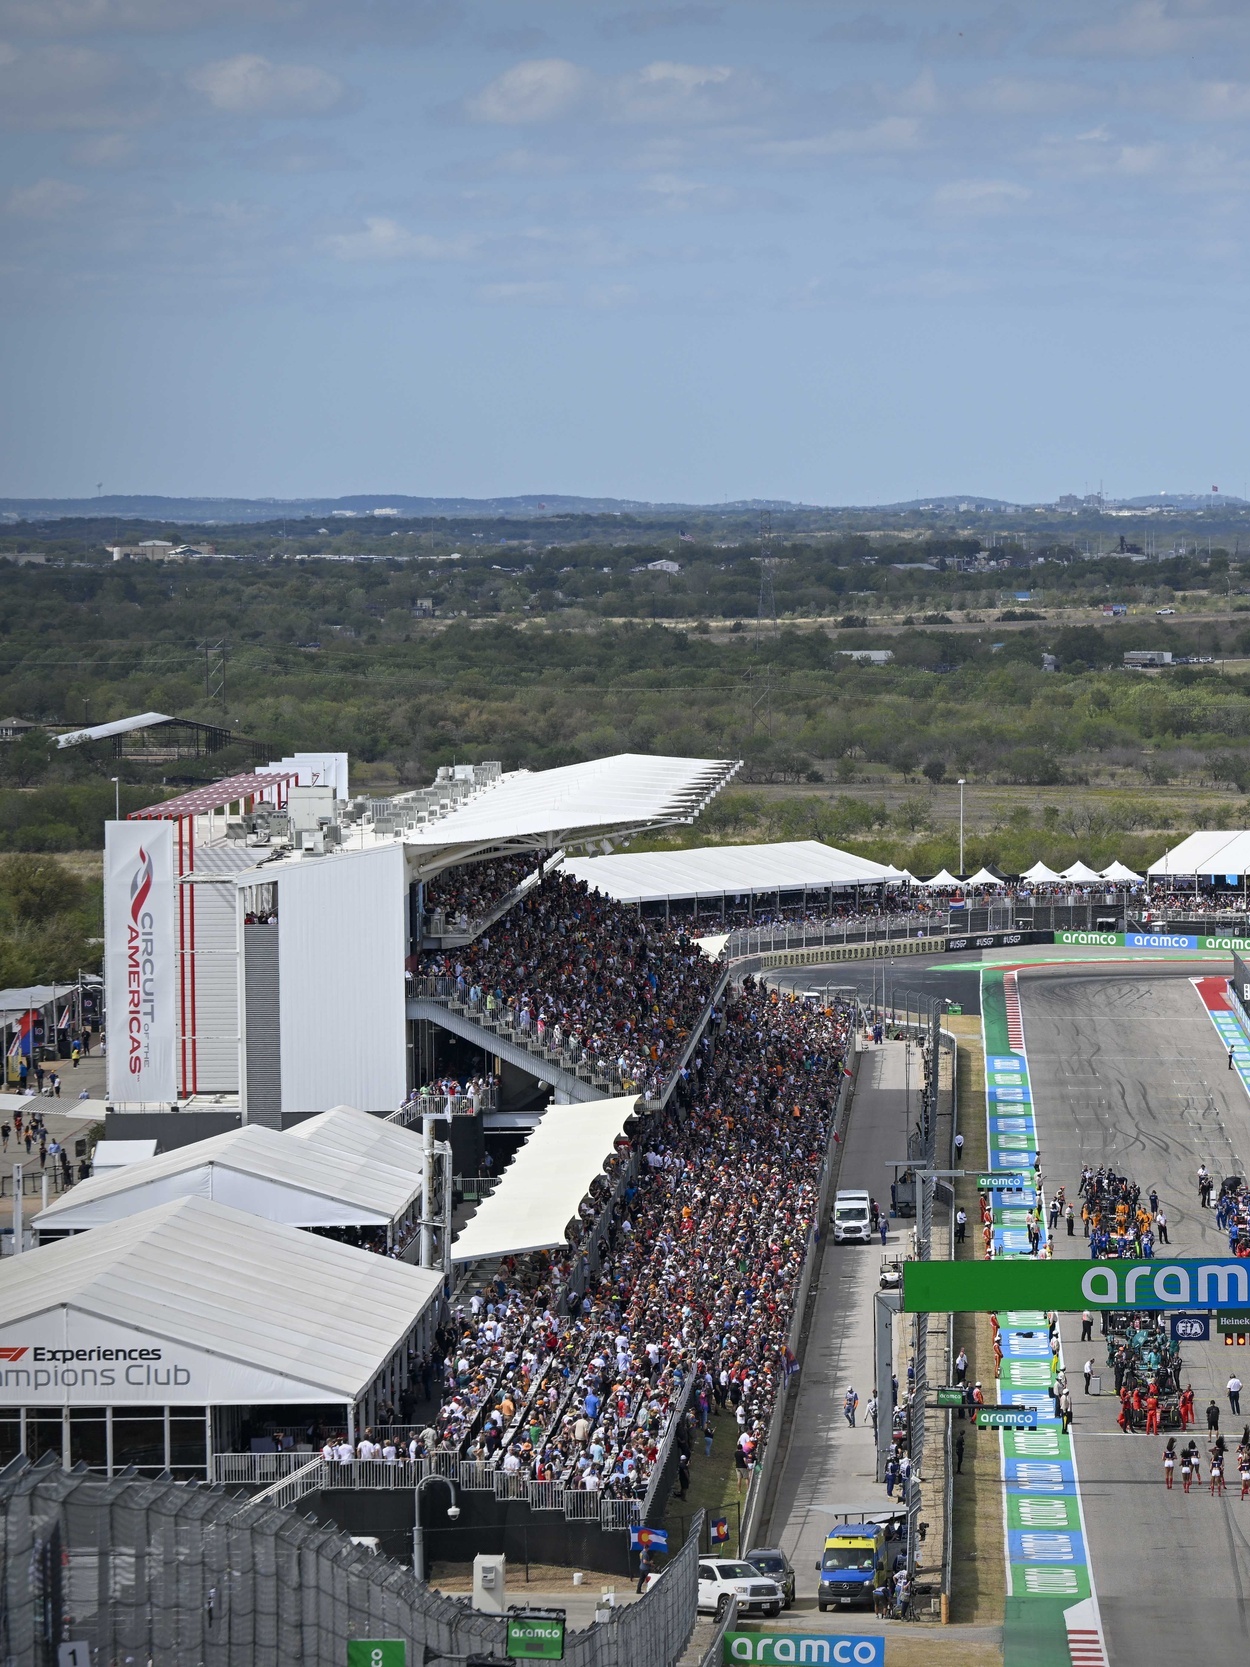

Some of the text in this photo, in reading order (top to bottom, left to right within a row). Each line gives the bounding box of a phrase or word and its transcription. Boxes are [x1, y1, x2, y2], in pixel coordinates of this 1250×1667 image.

[1063, 932, 1117, 945] aramco
[1134, 935, 1189, 948] aramco
[141, 911, 155, 1023] CIRCUIT
[127, 924, 142, 1075] AMERICAS
[980, 1178, 1021, 1186] aramco
[33, 1346, 162, 1364] Experiences
[0, 1364, 191, 1391] mpions Club
[980, 1413, 1034, 1424] aramco
[511, 1628, 560, 1638] aramco
[68, 1648, 78, 1666] 1
[731, 1637, 877, 1664] aramco
